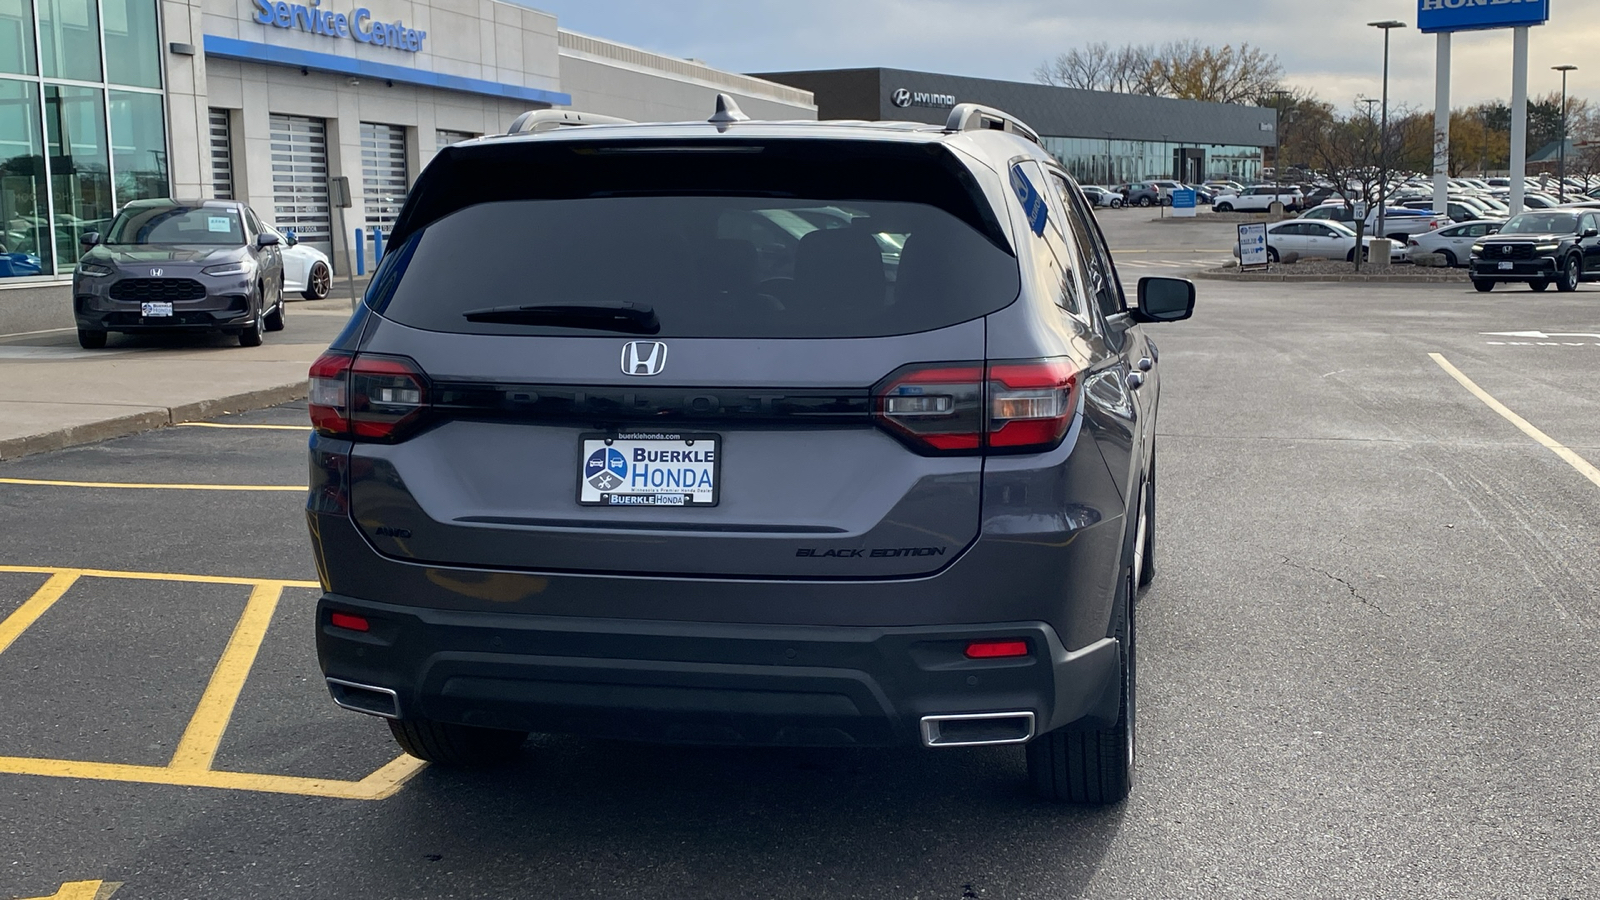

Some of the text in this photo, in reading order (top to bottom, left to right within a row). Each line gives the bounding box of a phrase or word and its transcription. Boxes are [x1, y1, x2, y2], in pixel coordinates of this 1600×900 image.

[1421, 0, 1540, 10] HON
[252, 0, 426, 52] Service Center
[914, 92, 956, 105] HYUNDAI
[618, 432, 681, 440] buerklehonda.com
[633, 447, 715, 462] BUERKLE
[631, 463, 713, 488] HONDA
[611, 494, 683, 504] BUERKLE HONDA
[375, 526, 411, 538] AWD
[796, 546, 947, 558] BLACK EDITION
